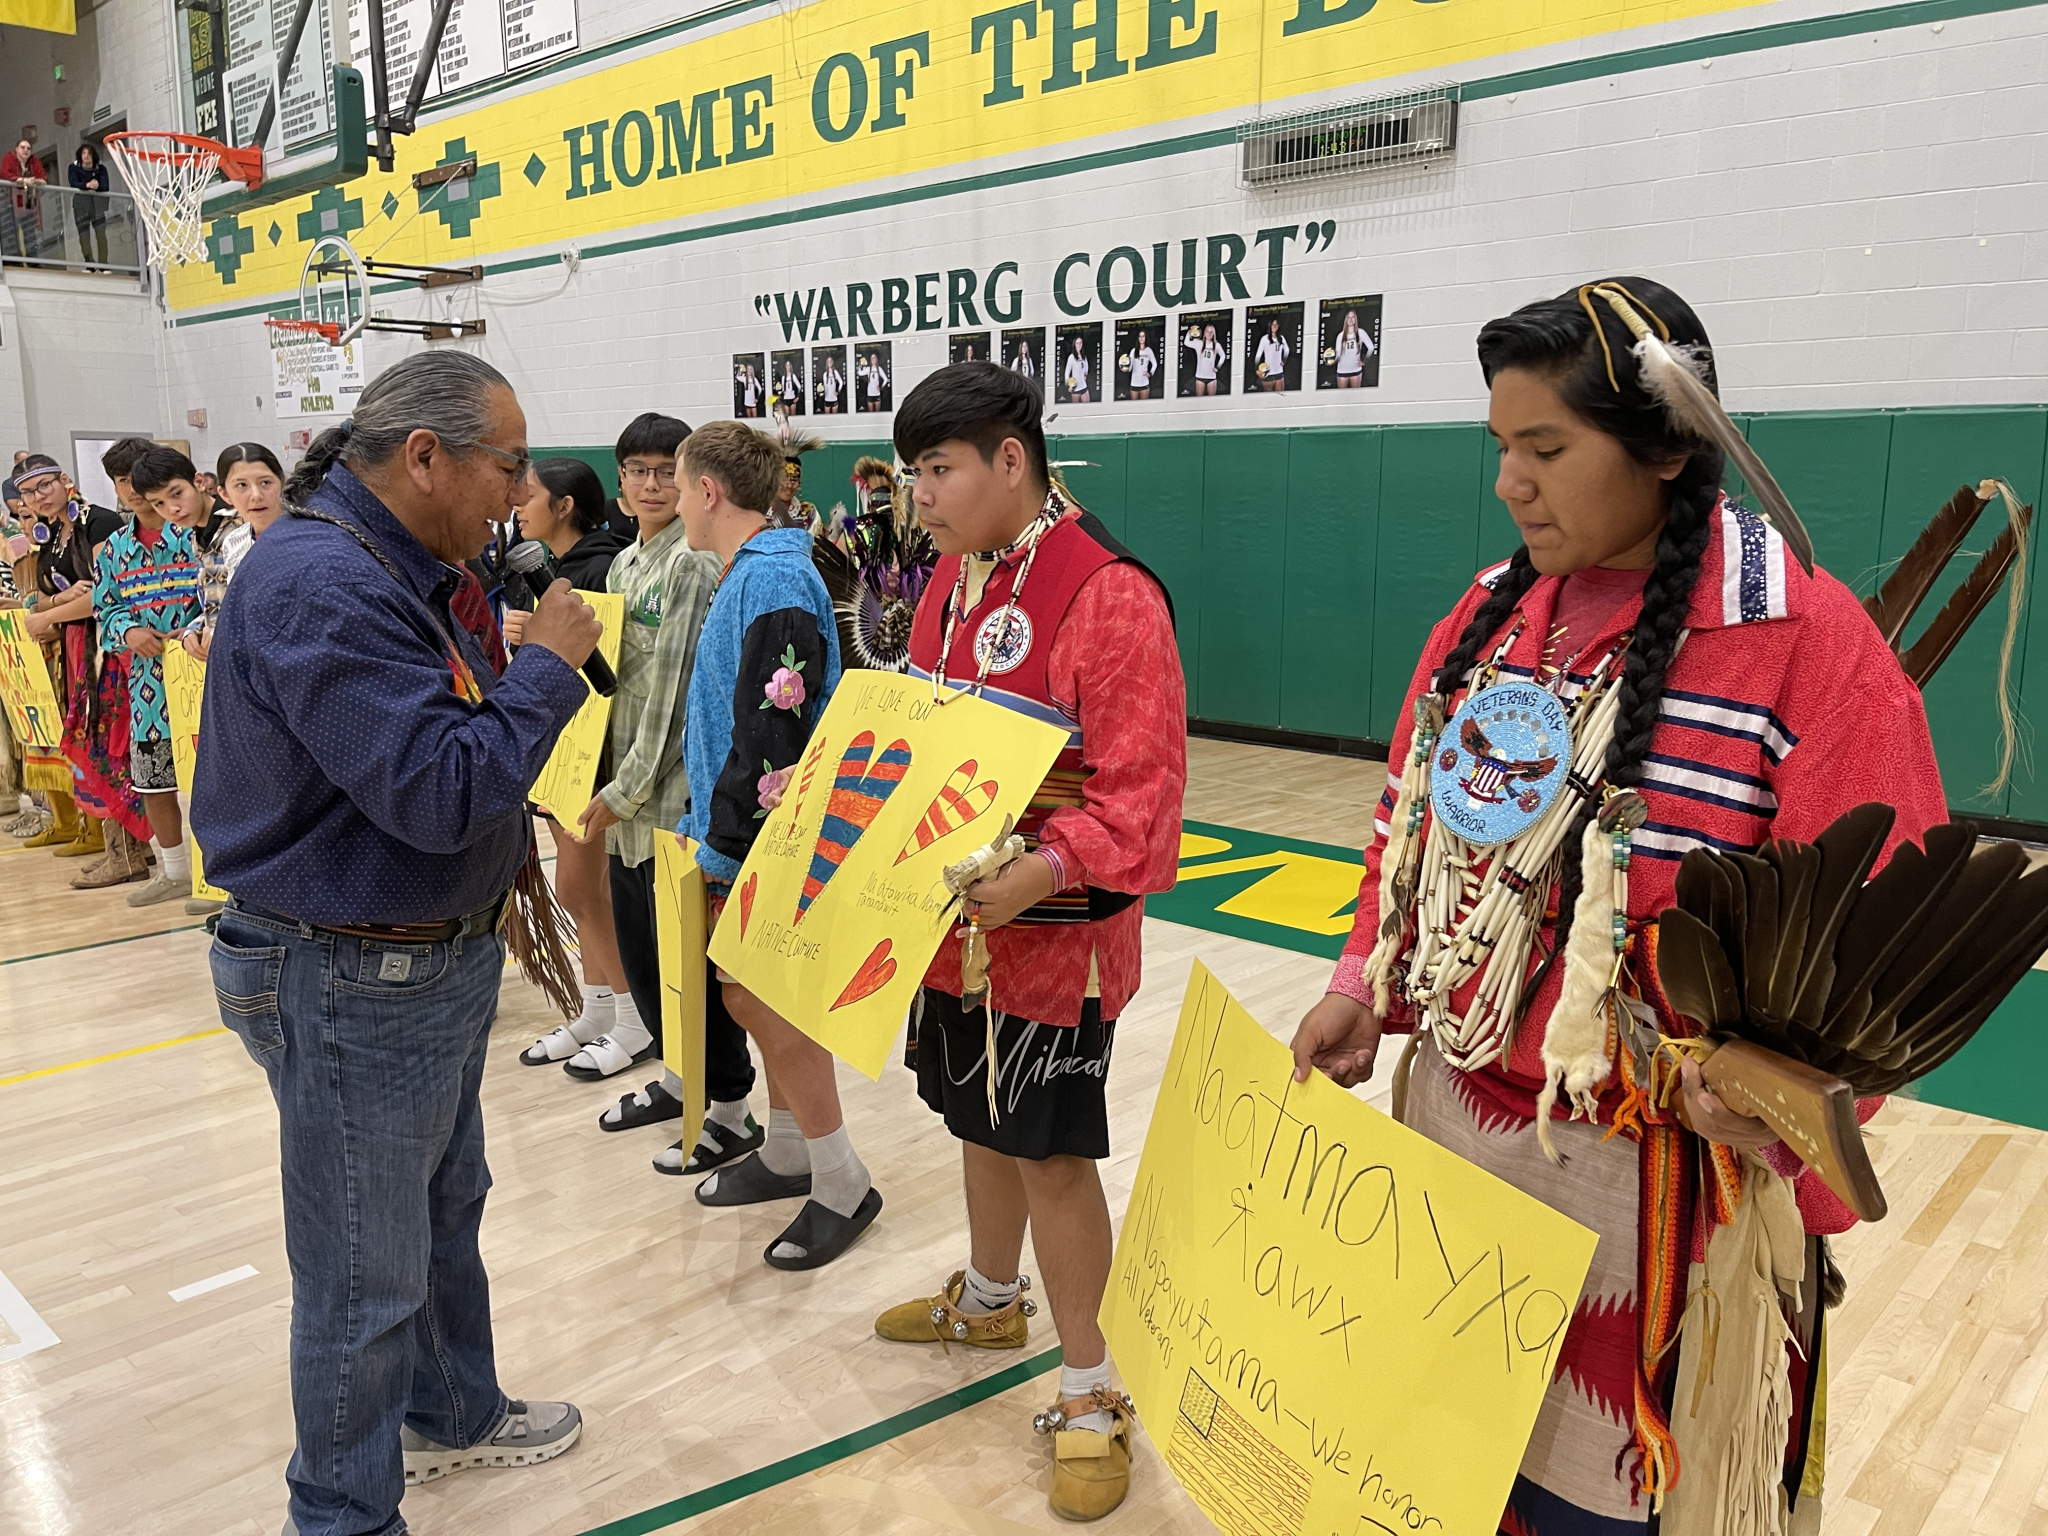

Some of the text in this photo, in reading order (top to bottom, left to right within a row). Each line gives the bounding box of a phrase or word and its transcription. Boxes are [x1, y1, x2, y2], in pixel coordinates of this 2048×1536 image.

[563, 0, 1217, 200] HOME OF THE
[1203, 350, 1212, 358] 10
[1346, 341, 1355, 350] 12
[300, 395, 334, 413] ATHLETICS
[853, 684, 877, 717] WE
[878, 686, 905, 712] LOVE
[1470, 690, 1562, 731] VETERANS DAY
[1122, 1256, 1175, 1370] All Veterans
[1359, 1454, 1443, 1530] honor
